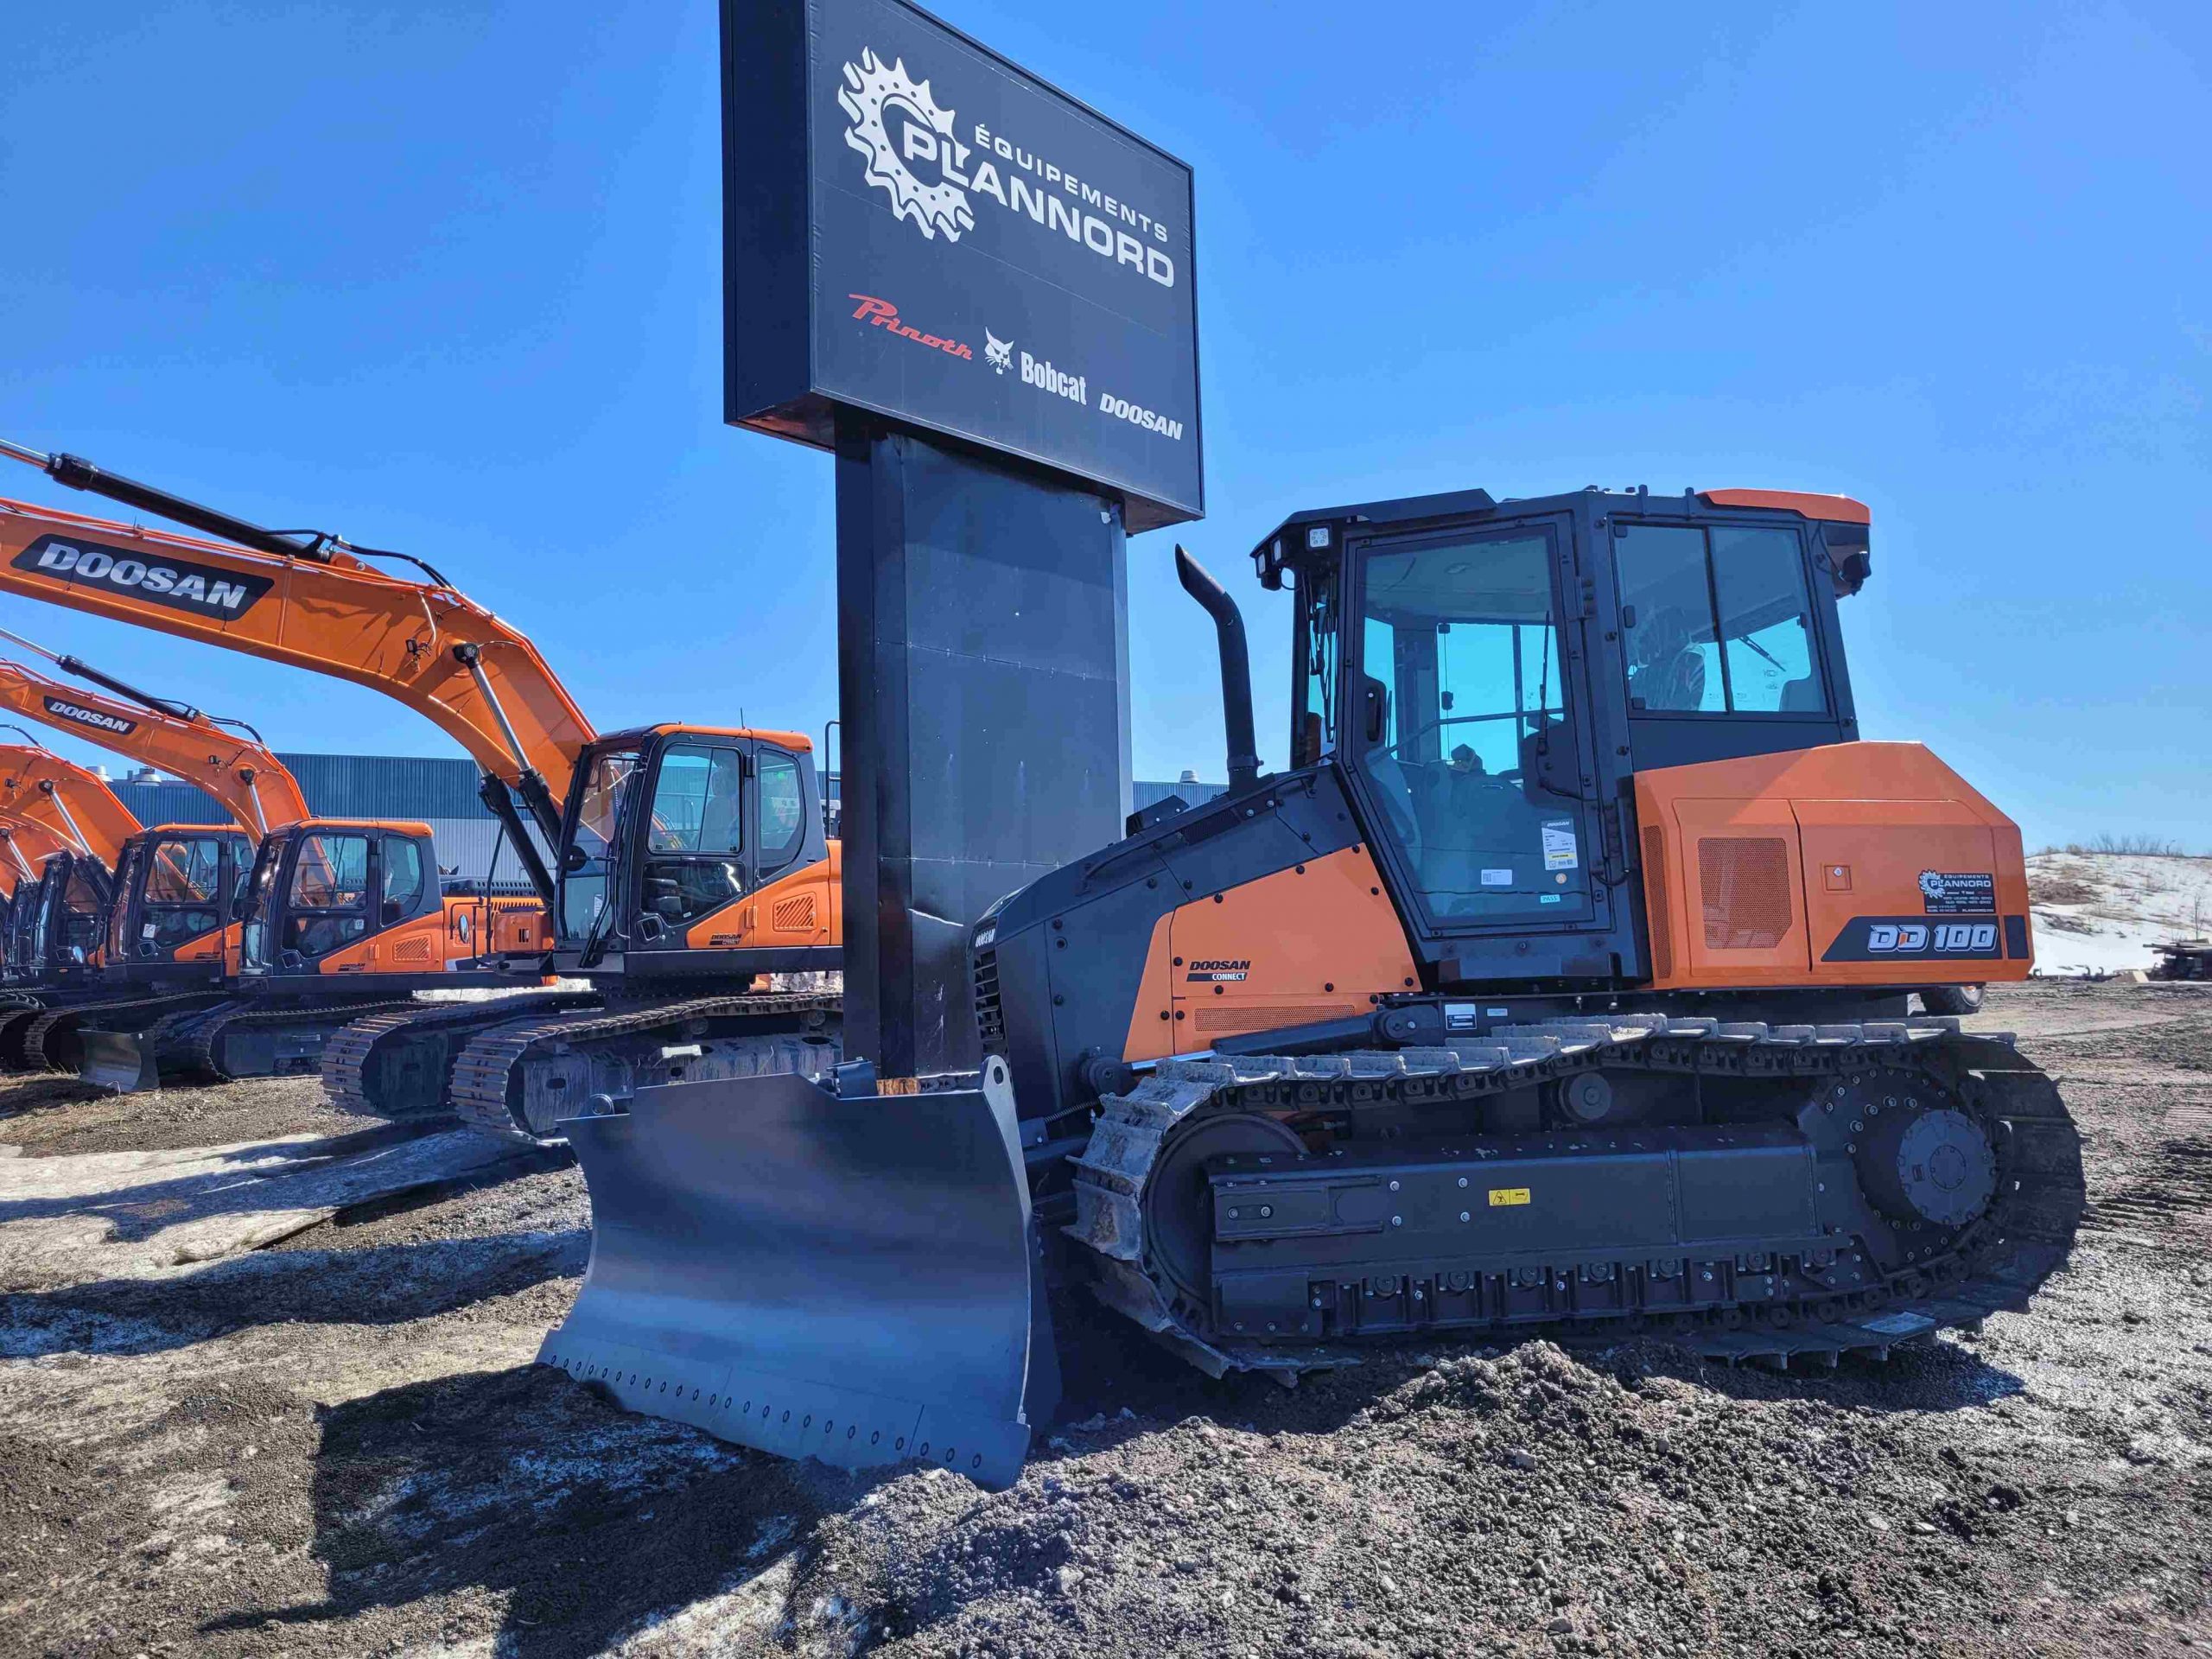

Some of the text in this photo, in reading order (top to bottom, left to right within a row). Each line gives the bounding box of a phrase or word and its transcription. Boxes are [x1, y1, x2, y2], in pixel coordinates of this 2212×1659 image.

[903, 120, 1174, 288] PLANNORD
[975, 124, 1167, 242] ÉQUIPEMENTS
[849, 294, 1183, 441] Prinoth Bobcat DOOSAN
[38, 543, 247, 608] DOOSAN
[49, 702, 130, 732] DOOSAN
[1189, 960, 1251, 970] DOOSAN
[1867, 925, 1999, 952] DD 100
